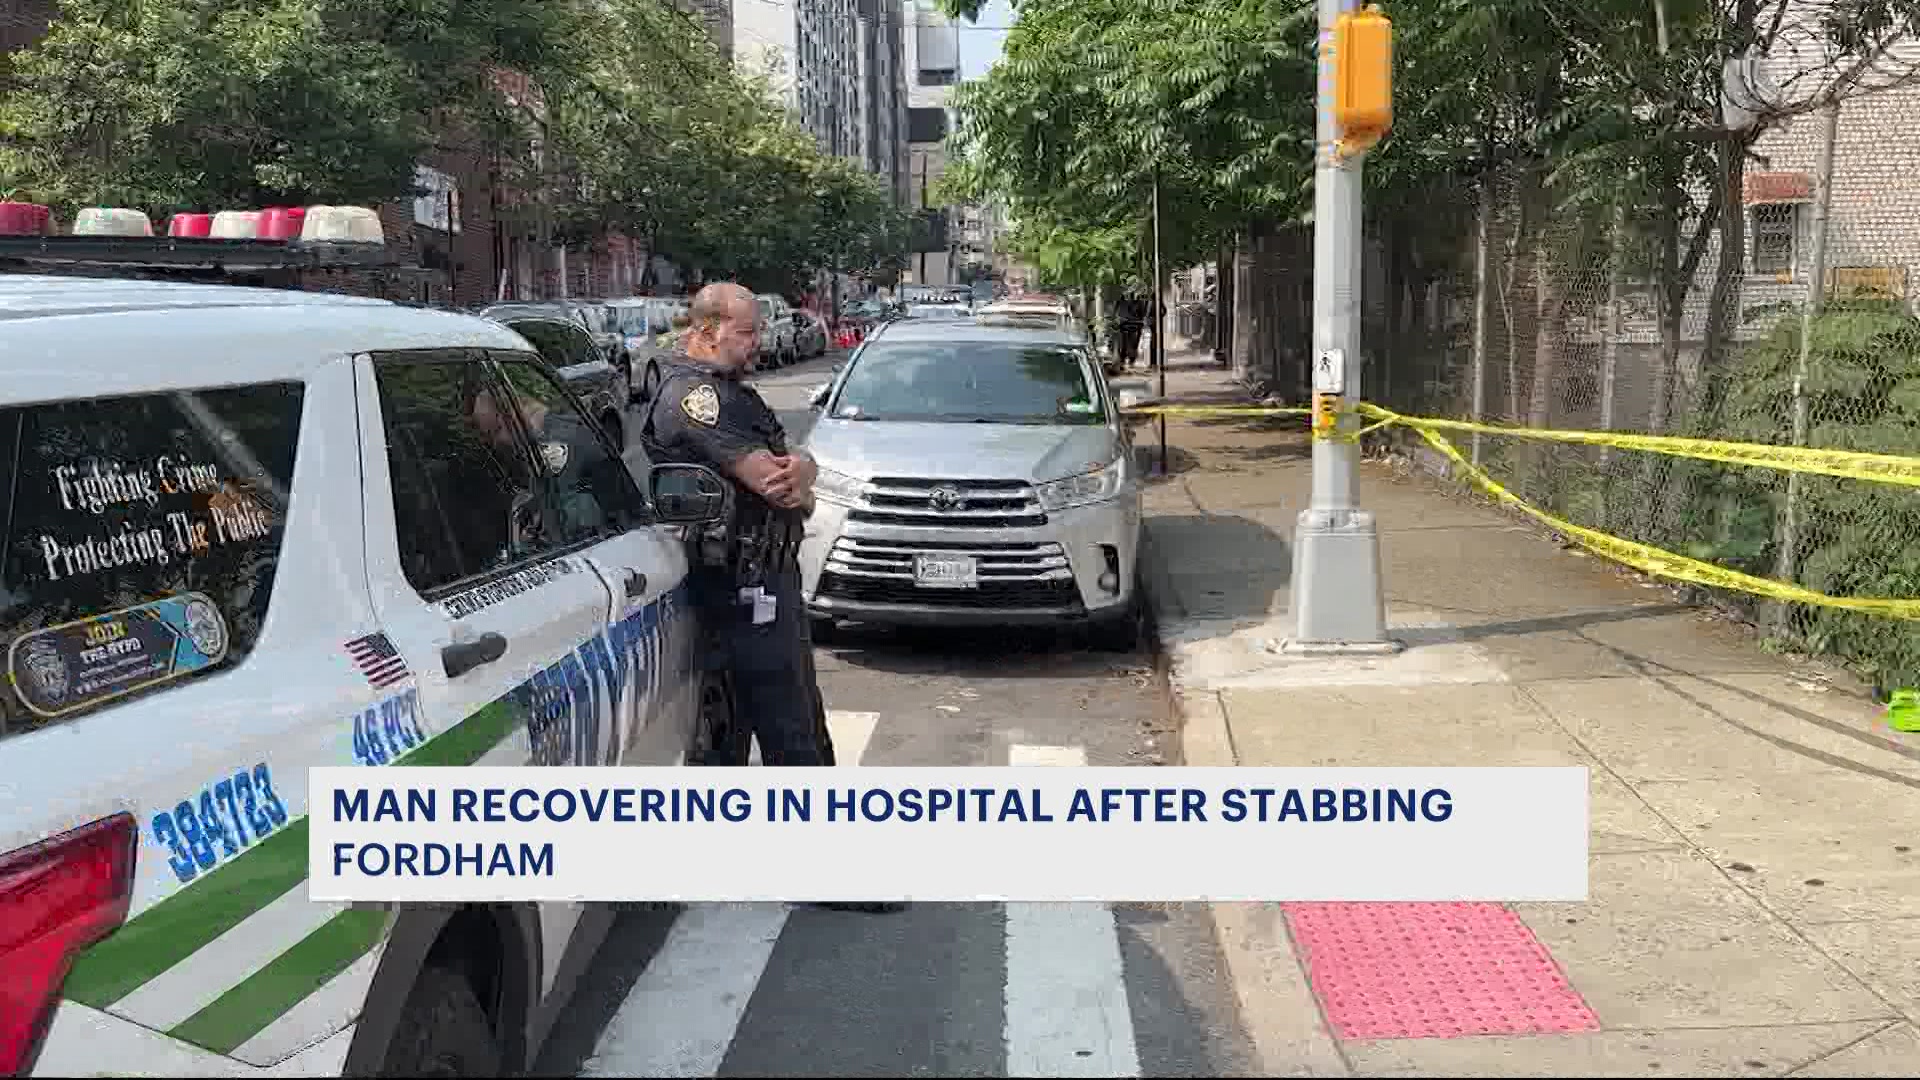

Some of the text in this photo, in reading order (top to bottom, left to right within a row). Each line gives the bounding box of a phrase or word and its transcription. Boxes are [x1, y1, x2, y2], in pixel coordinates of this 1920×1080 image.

[55, 457, 160, 514] Fighting
[39, 499, 272, 581] Protecting The Public
[152, 762, 288, 883] 384723
